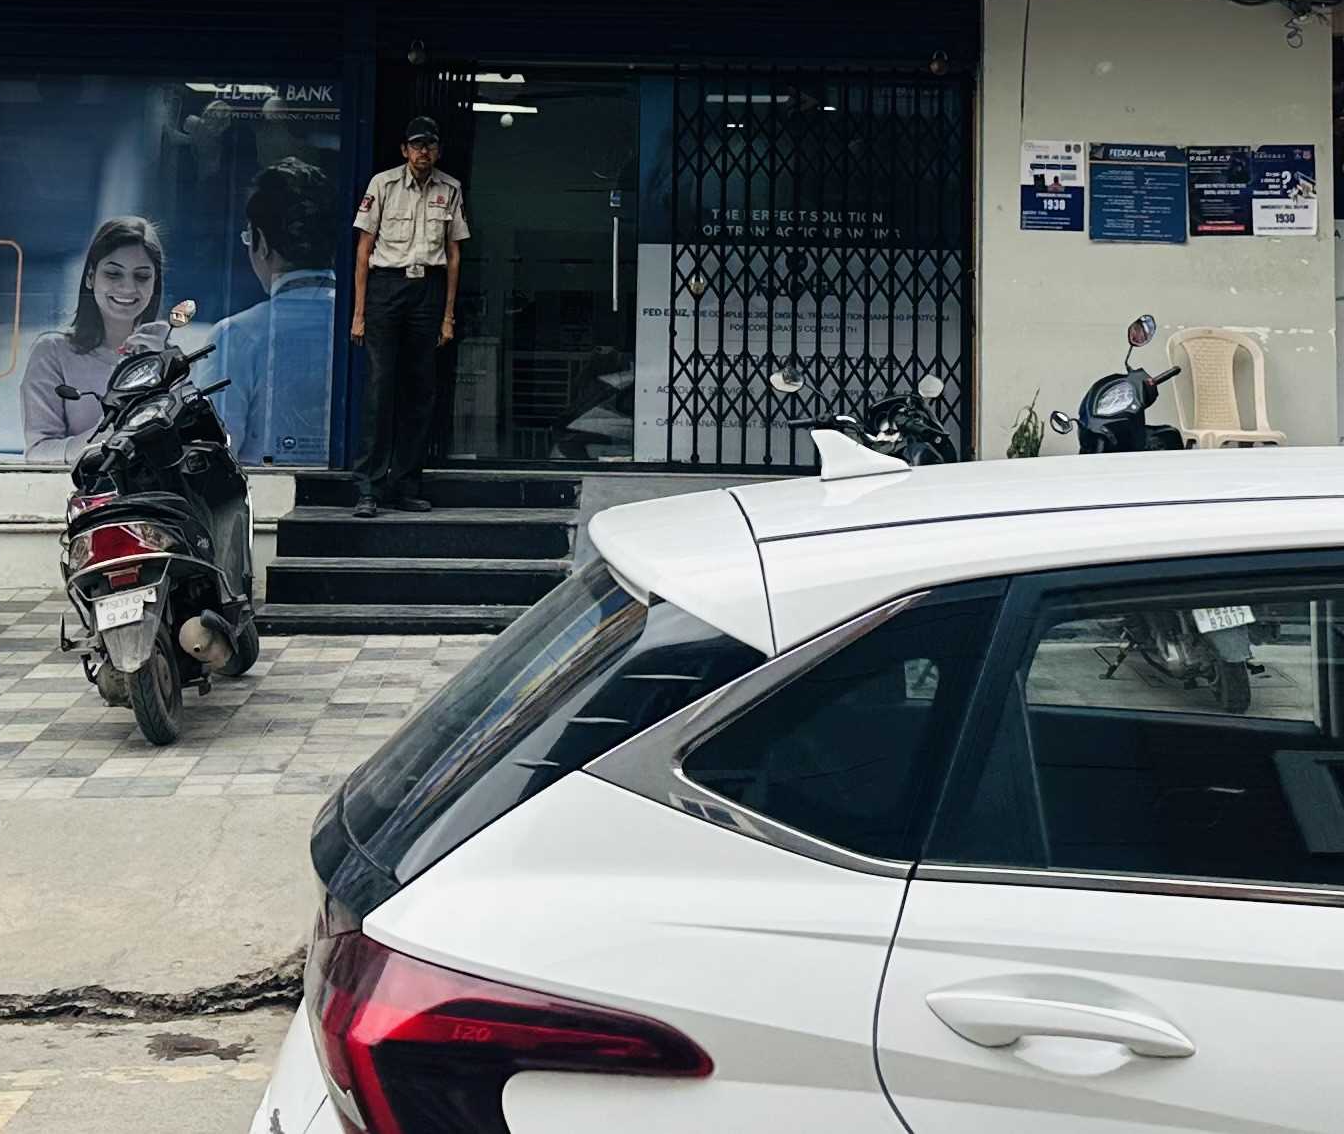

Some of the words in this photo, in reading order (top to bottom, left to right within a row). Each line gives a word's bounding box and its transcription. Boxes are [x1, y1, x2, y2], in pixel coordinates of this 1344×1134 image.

[285, 84, 334, 104] BANK
[1109, 147, 1143, 159] FEDERAL
[1144, 148, 1168, 159] BANK
[1042, 198, 1067, 211] 1930
